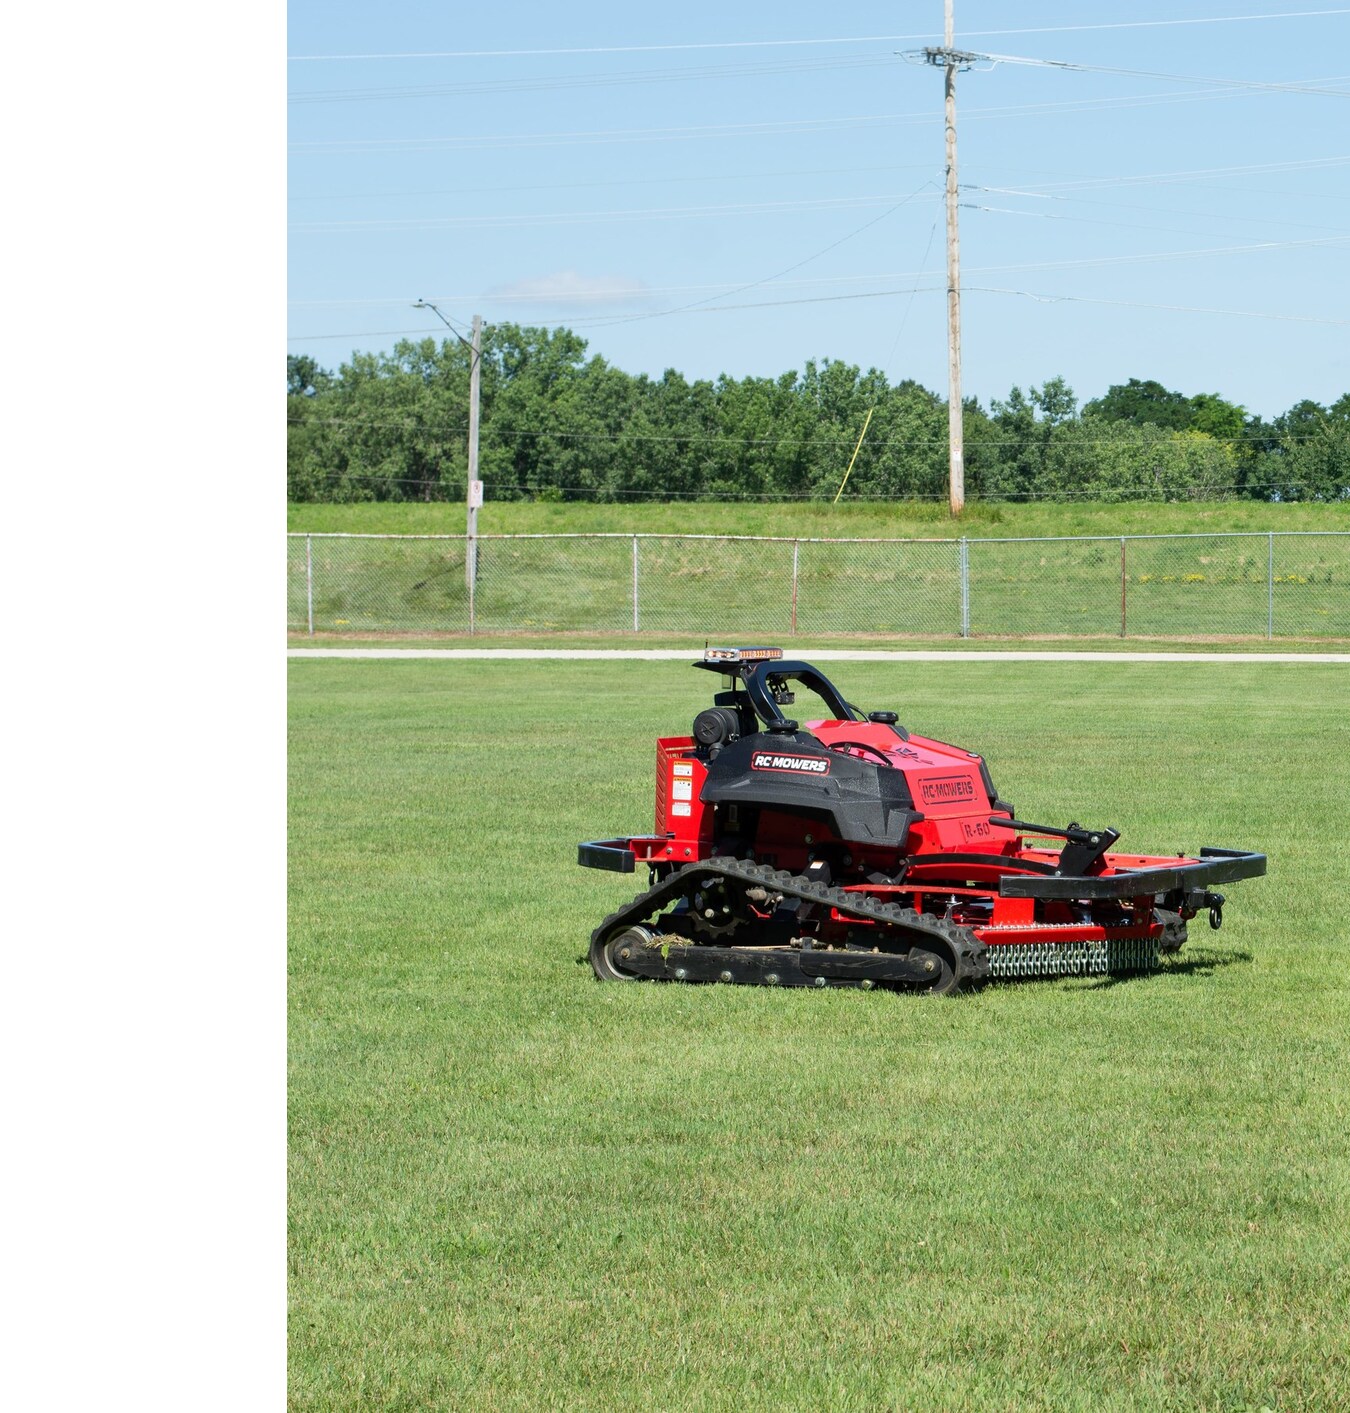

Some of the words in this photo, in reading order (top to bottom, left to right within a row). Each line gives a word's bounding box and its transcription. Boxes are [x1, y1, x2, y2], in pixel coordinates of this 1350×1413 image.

[754, 755, 772, 767] RC
[771, 757, 828, 772] MOWERS
[922, 784, 936, 799] RC
[935, 781, 974, 798] MOWERS
[964, 822, 991, 838] R-60
